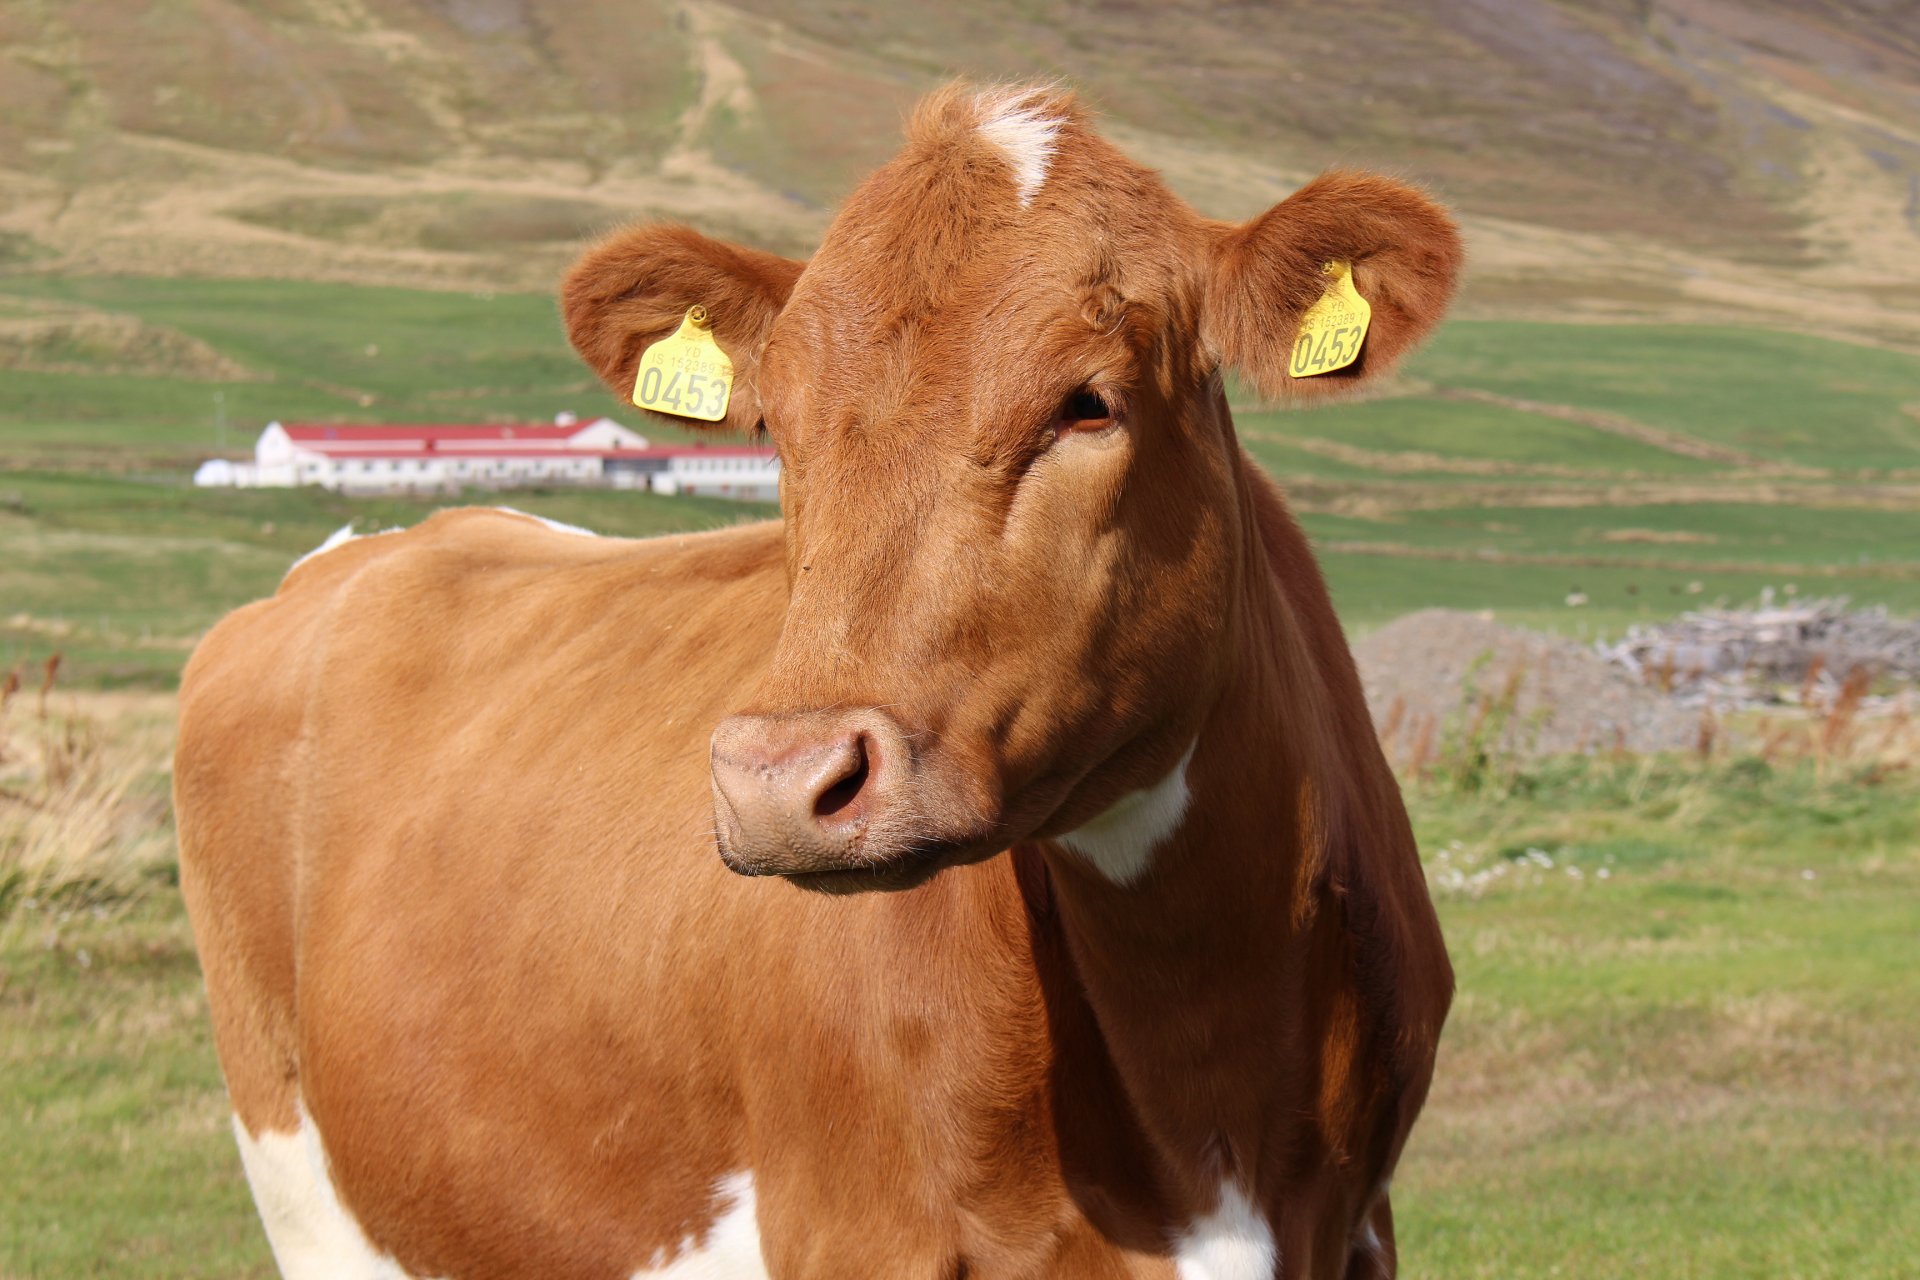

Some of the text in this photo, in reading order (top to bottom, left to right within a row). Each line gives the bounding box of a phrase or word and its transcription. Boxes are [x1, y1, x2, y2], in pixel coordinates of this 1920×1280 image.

[1320, 313, 1355, 327] 152389
[684, 346, 701, 358] YD
[1295, 325, 1362, 373] 0453
[651, 353, 664, 365] IS
[671, 357, 716, 374] 152389
[640, 367, 726, 416] 0453
